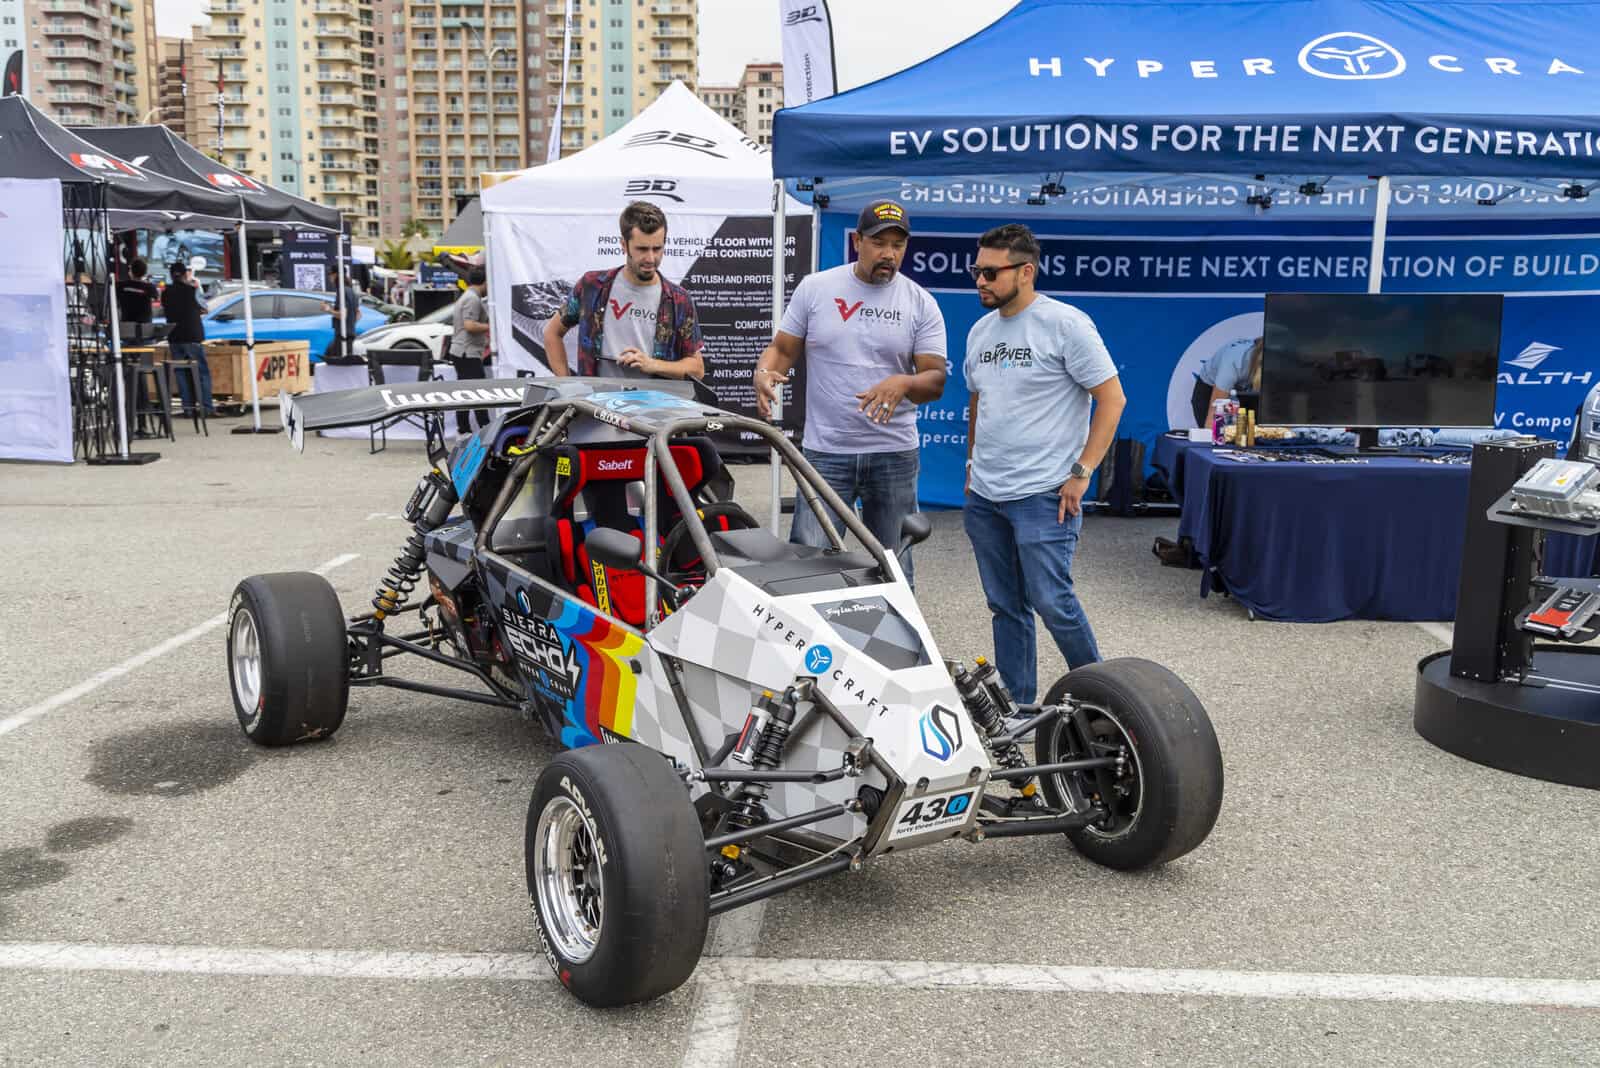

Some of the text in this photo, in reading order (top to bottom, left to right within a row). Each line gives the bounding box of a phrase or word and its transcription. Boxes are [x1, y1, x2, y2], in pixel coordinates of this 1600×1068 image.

[1029, 55, 1584, 78] HYPER CRA
[890, 123, 1600, 157] EV SOLUTIONS FOR THE NEXT GENERATI
[673, 238, 712, 246] VEHICLE
[714, 238, 746, 247] FLOOR
[748, 237, 773, 246] WITH
[1076, 256, 1130, 277] FOR
[1139, 256, 1191, 278] THE
[1202, 256, 1270, 278] NEXT
[1465, 256, 1504, 278] OF
[1513, 254, 1600, 276] BUILD
[691, 275, 724, 284] STYLISH
[725, 275, 742, 284] AND
[860, 307, 901, 321] reVolt
[713, 370, 752, 379] ANTI-SKID
[1512, 412, 1572, 432] Compo
[597, 460, 633, 471] Sabelt
[502, 608, 559, 643] SIERRA
[753, 604, 806, 650] HYPER
[504, 625, 567, 676] ECHO
[833, 669, 889, 717] CRAFT
